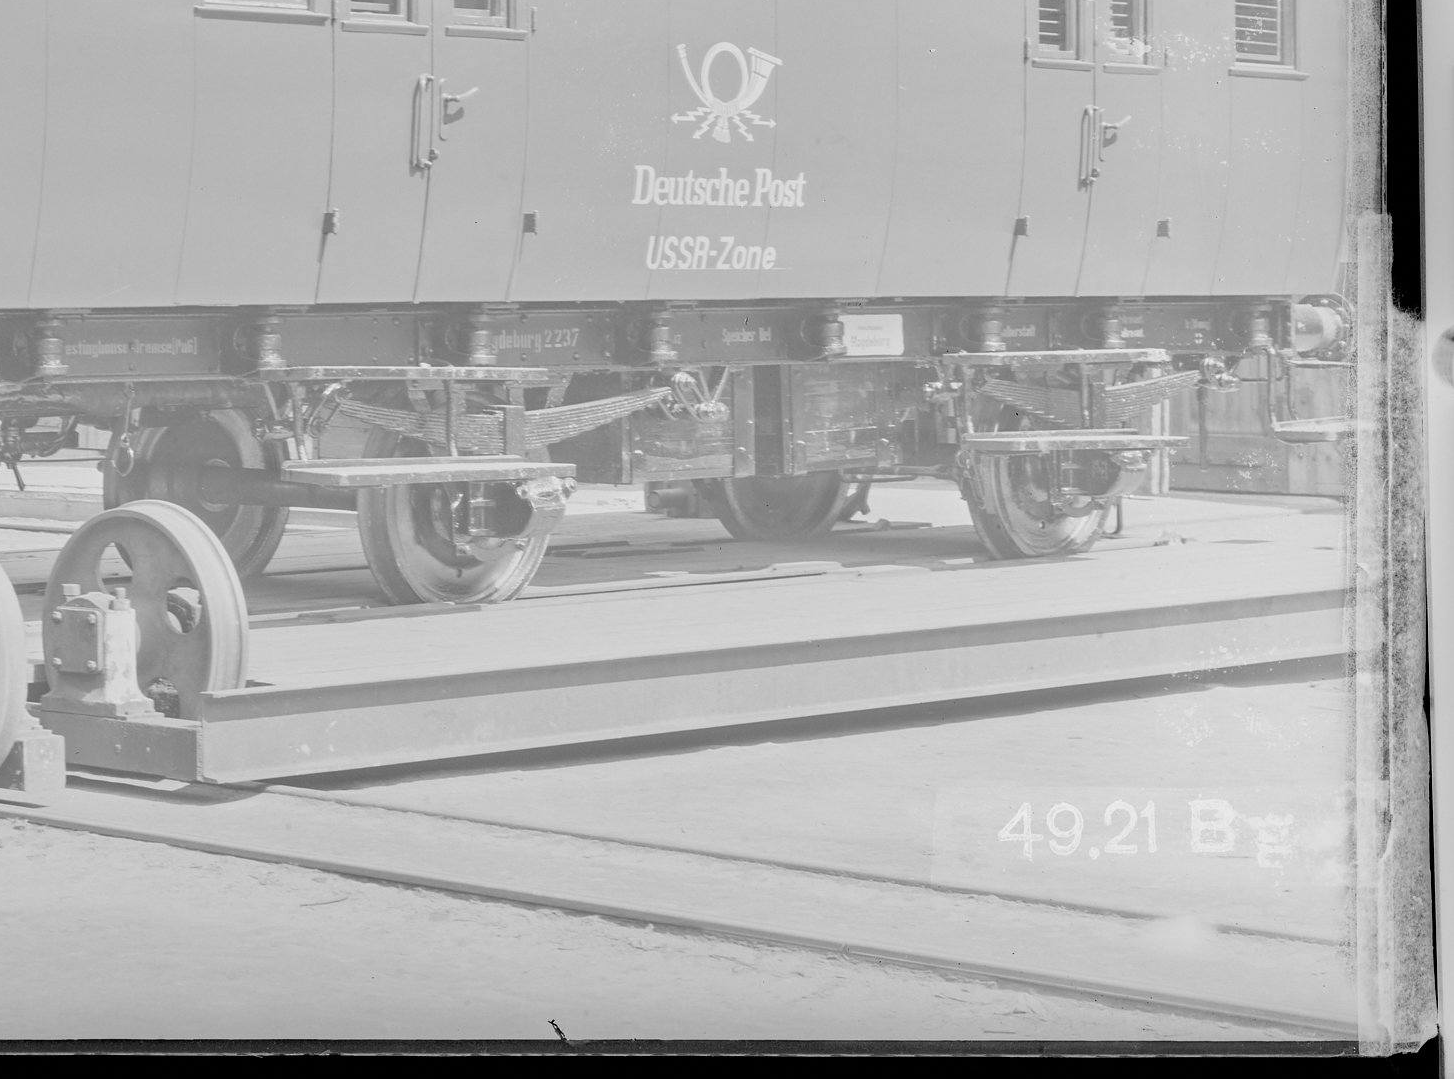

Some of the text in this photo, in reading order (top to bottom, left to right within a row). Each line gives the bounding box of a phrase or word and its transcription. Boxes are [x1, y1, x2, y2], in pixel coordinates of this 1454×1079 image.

[631, 164, 807, 208] Deutsche Post
[645, 235, 777, 270] USSR-Zone
[544, 327, 581, 349] 2237
